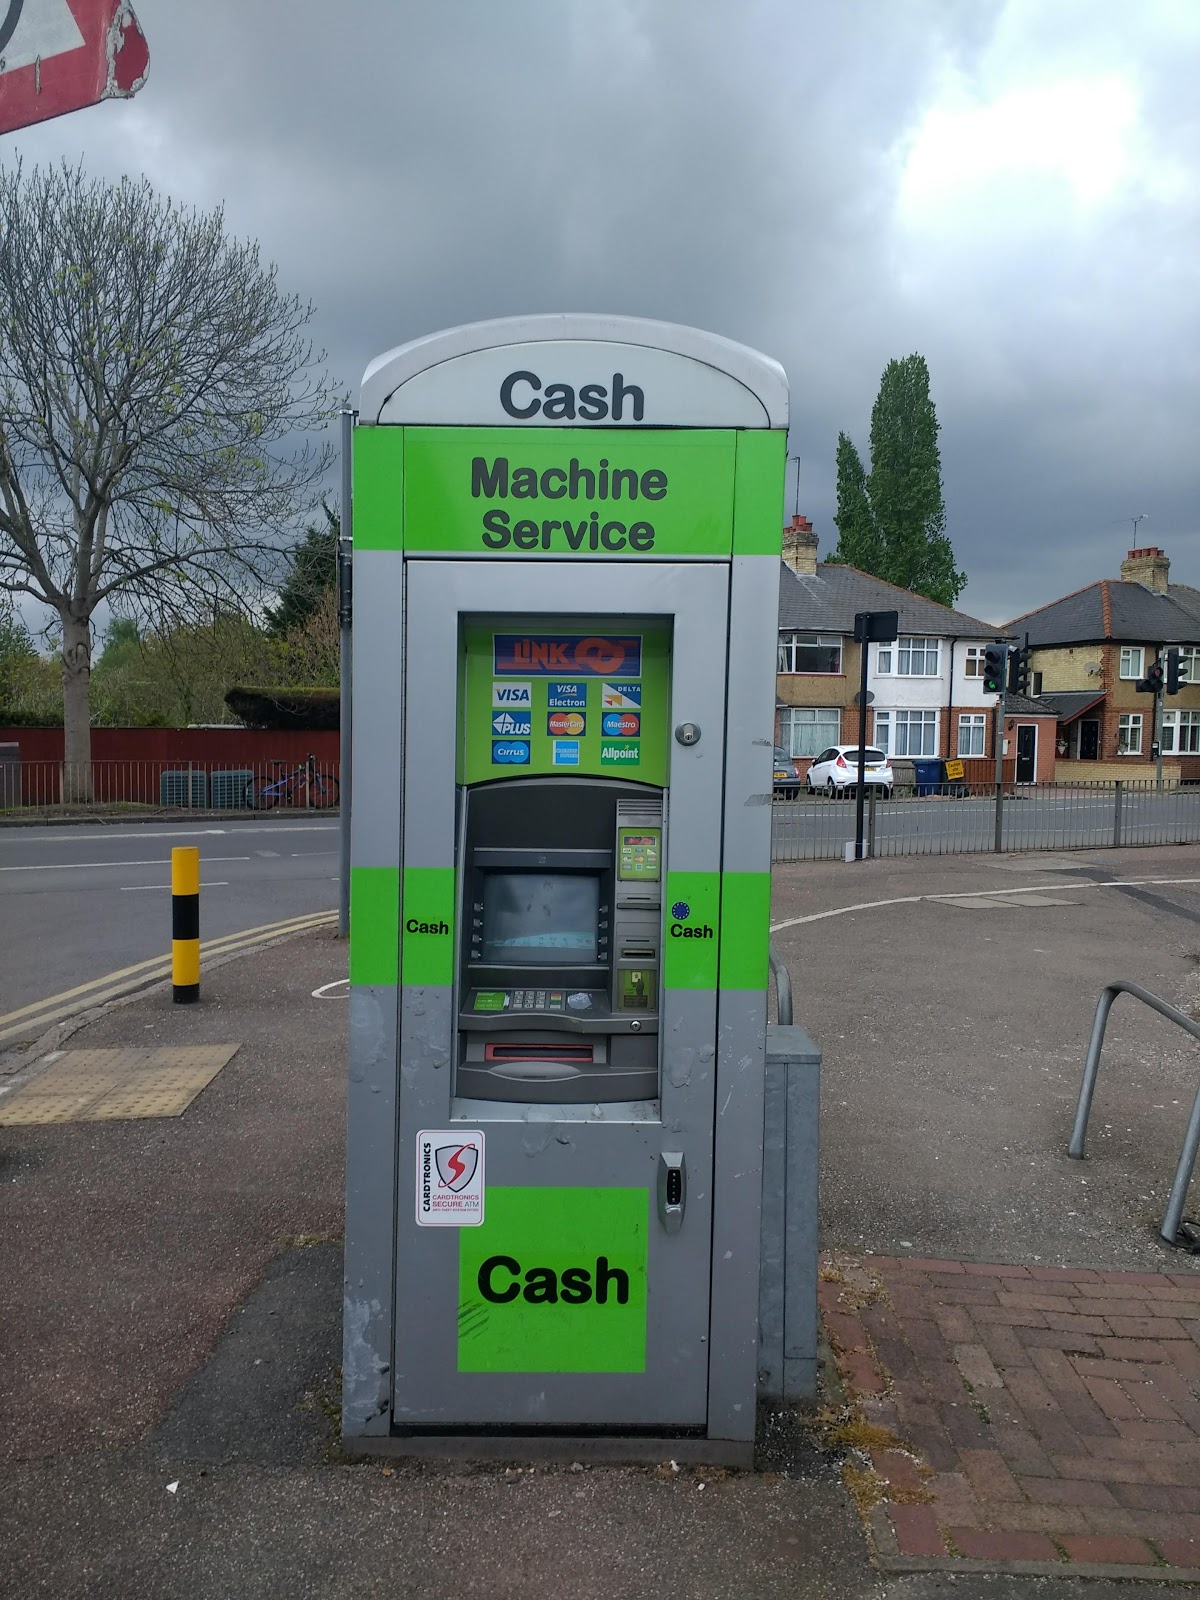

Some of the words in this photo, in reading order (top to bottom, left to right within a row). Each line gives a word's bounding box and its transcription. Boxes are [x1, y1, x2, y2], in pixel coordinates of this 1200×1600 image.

[499, 370, 645, 422] Cash
[471, 456, 669, 501] Machine
[481, 509, 656, 552] Service
[514, 638, 569, 667] LINK
[496, 689, 530, 701] VISA
[550, 698, 585, 706] Electron
[504, 723, 530, 734] PLUS
[549, 720, 585, 728] MasterCard
[606, 720, 636, 729] Maestro
[497, 748, 525, 756] Cirrus
[602, 745, 639, 761] Allpoint
[406, 918, 449, 936] Cash
[670, 923, 714, 939] Cash
[477, 1255, 630, 1305] Cash
